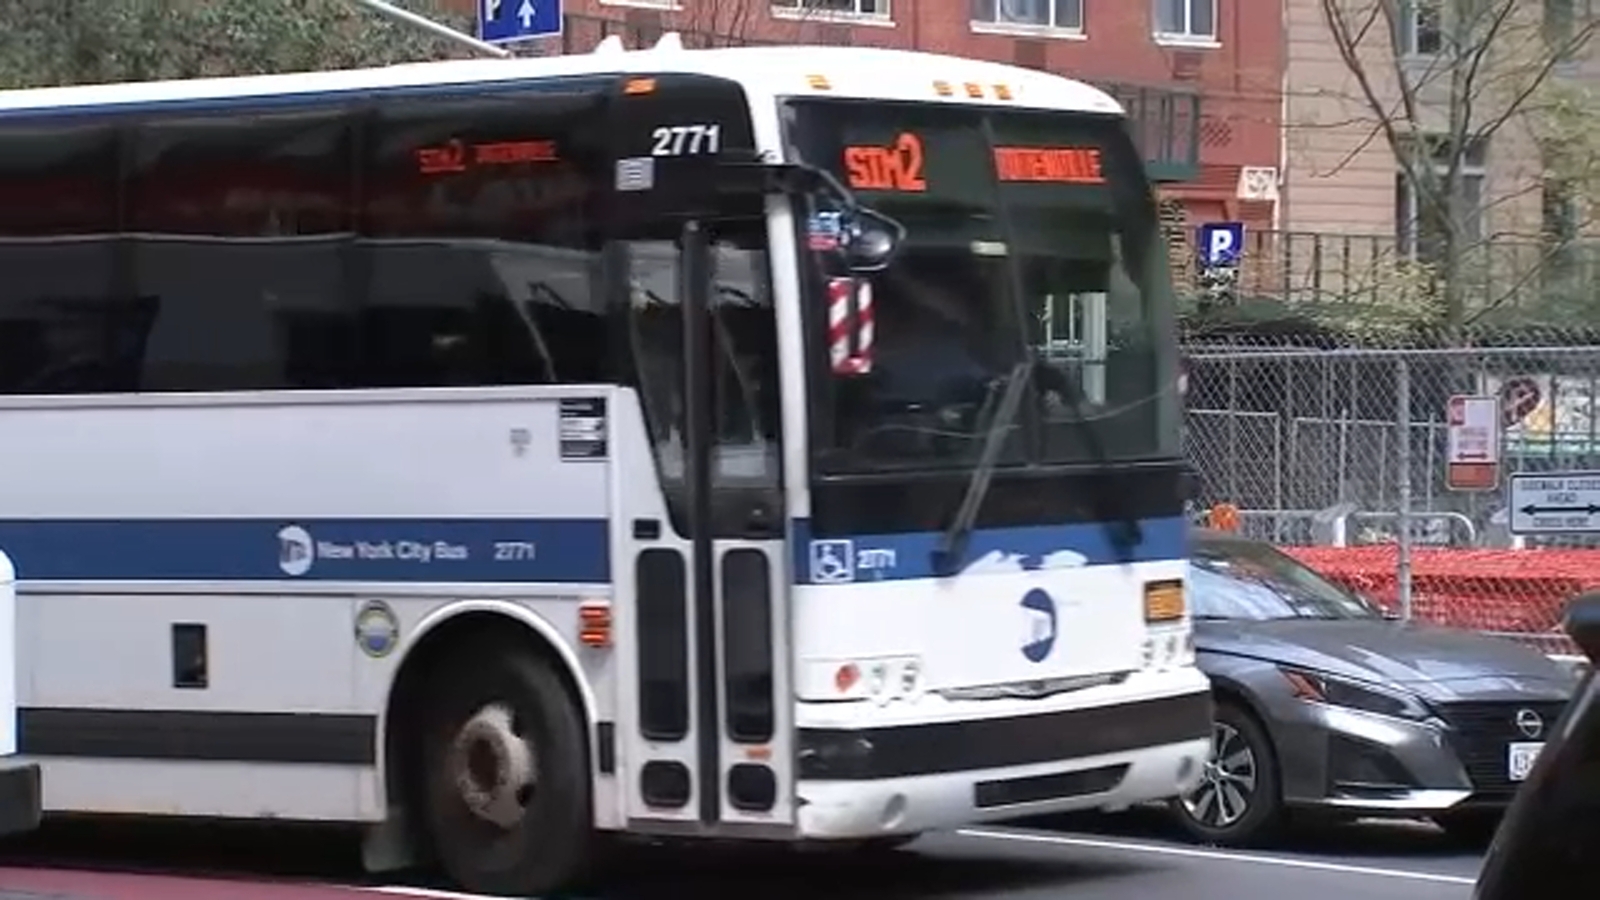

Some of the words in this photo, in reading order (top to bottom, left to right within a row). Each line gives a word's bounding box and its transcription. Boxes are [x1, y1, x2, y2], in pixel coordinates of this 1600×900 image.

[652, 124, 720, 156] 2771
[1210, 229, 1233, 262] P
[317, 541, 355, 559] New
[355, 541, 396, 559] York
[397, 541, 431, 563] City
[434, 541, 468, 560] Bus
[494, 542, 536, 560] 2771
[858, 549, 897, 569] 2771
